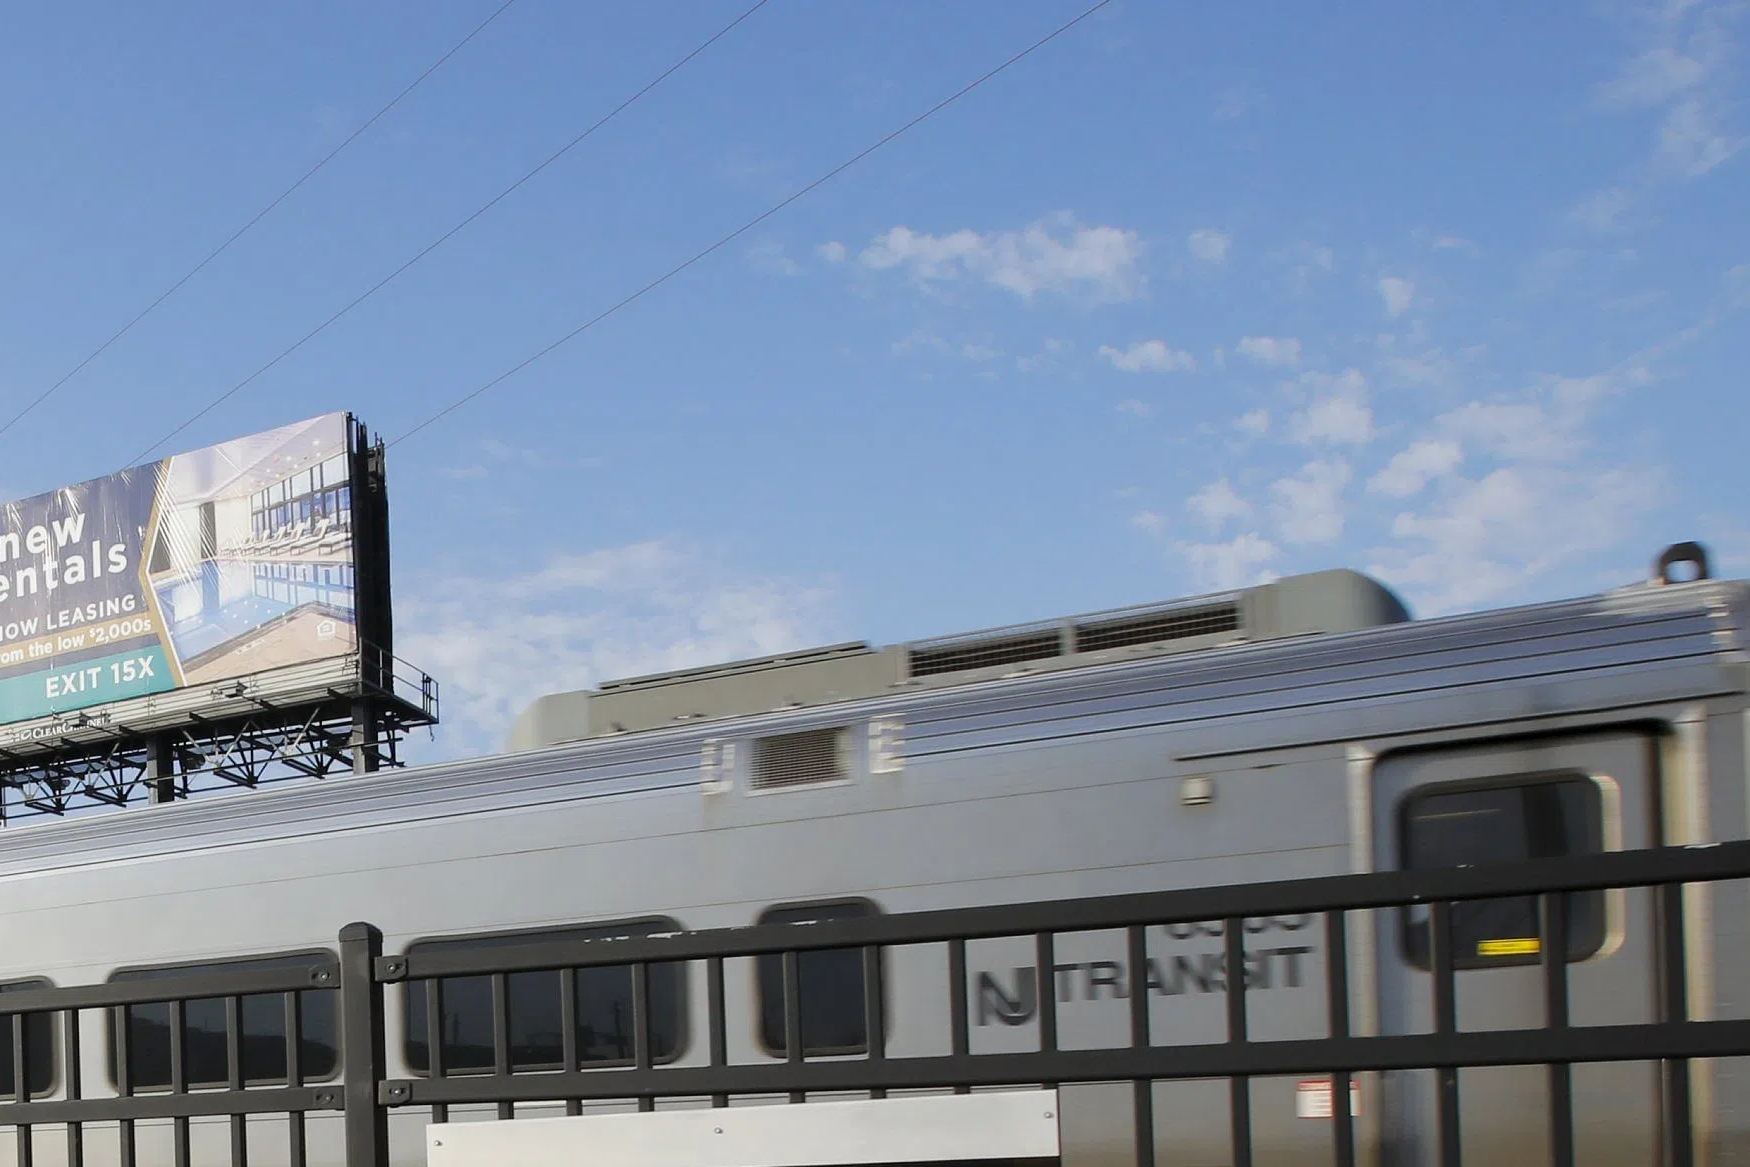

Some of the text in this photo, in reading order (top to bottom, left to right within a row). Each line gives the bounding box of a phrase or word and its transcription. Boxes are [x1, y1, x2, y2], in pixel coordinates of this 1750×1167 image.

[47, 594, 136, 630] LEASING
[29, 641, 53, 658] the
[58, 634, 85, 652] low
[89, 618, 152, 643] $2,000s
[46, 655, 155, 698] EXIT 15X
